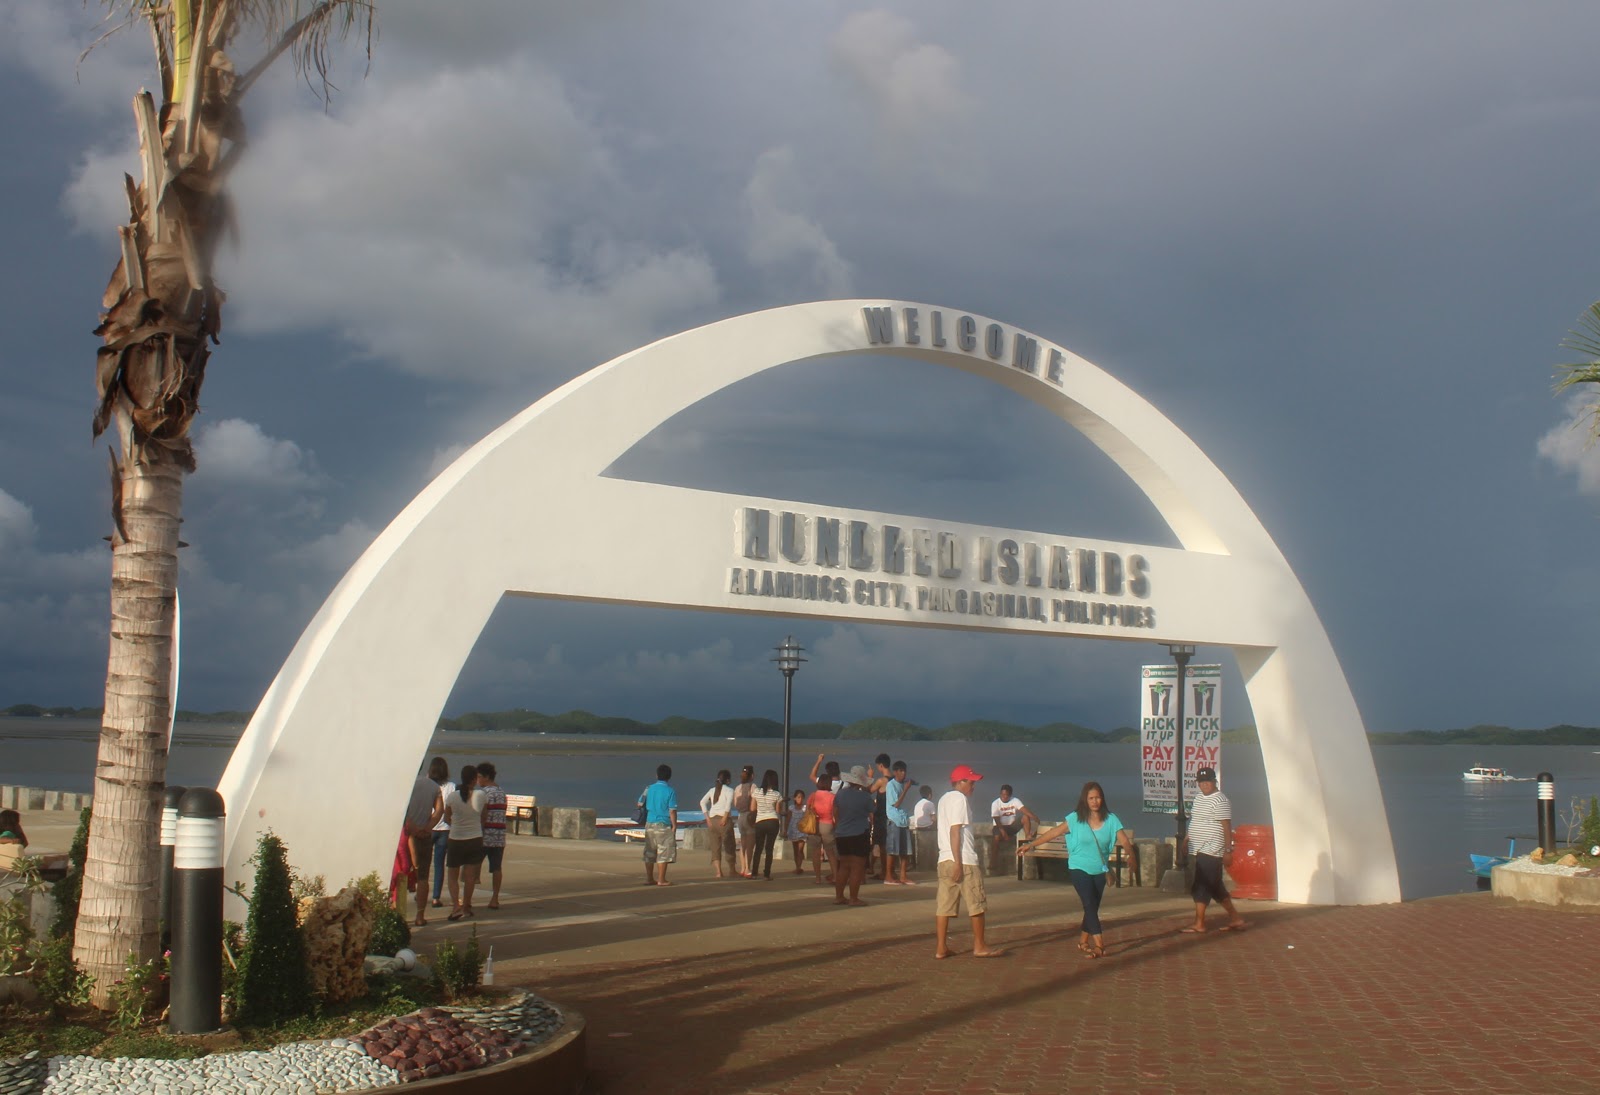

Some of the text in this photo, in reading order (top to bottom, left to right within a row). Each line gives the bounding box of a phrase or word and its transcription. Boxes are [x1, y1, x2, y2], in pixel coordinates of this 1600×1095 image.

[861, 306, 1065, 386] WELCOME
[740, 507, 1150, 598] HUNDRED ISLANDS
[1143, 717, 1175, 731] PICK
[1185, 717, 1219, 731] PICK
[1146, 731, 1174, 741] IT UP
[1189, 731, 1218, 741] IT UP
[1142, 745, 1175, 760] PAY
[1184, 745, 1219, 761] PAY
[1144, 761, 1173, 771] IT OUT
[1185, 761, 1196, 771] IT
